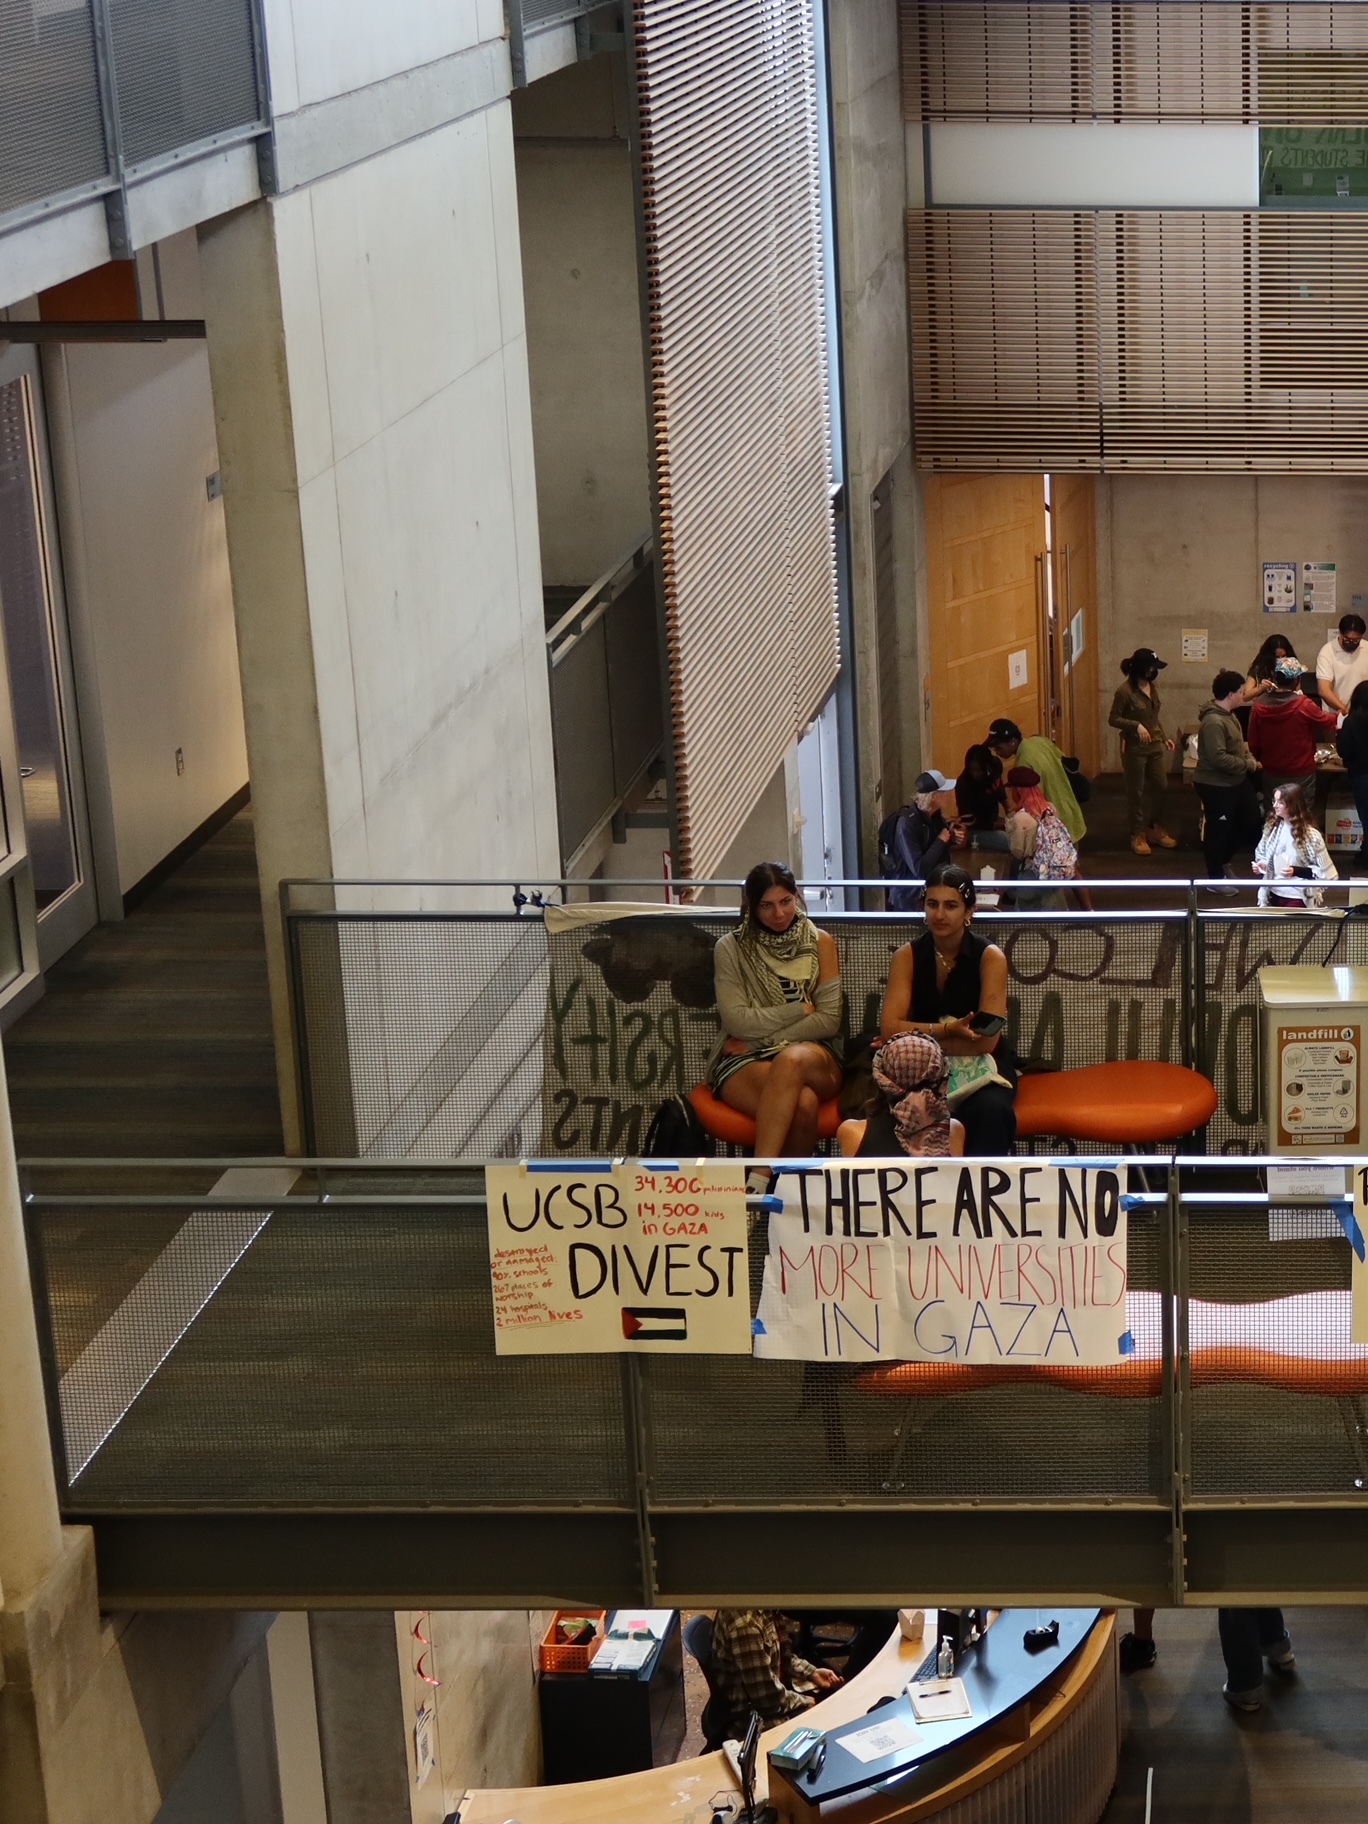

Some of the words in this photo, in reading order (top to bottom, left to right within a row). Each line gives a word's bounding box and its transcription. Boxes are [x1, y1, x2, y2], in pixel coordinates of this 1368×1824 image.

[1282, 1029, 1338, 1040] landfill
[502, 1183, 628, 1232] UCSB
[788, 1166, 939, 1240] THERE
[955, 1166, 1042, 1239] ARE
[1057, 1167, 1119, 1238] NO
[642, 1220, 658, 1236] in
[663, 1221, 708, 1236] GAZA
[494, 1244, 549, 1259] destroyed
[490, 1260, 503, 1269] or
[567, 1242, 743, 1300] DIVEST
[513, 1267, 549, 1278] schools
[779, 1243, 887, 1302] MORE
[907, 1240, 1127, 1308] UNIVERSITIES
[510, 1281, 539, 1293] places
[542, 1278, 554, 1289] of
[495, 1291, 534, 1302] worship
[510, 1301, 548, 1314] hospitals
[496, 1317, 503, 1327] 2
[505, 1314, 542, 1325] million
[548, 1309, 584, 1321] lives
[820, 1300, 881, 1357] IN
[912, 1299, 1082, 1358] GAZA
